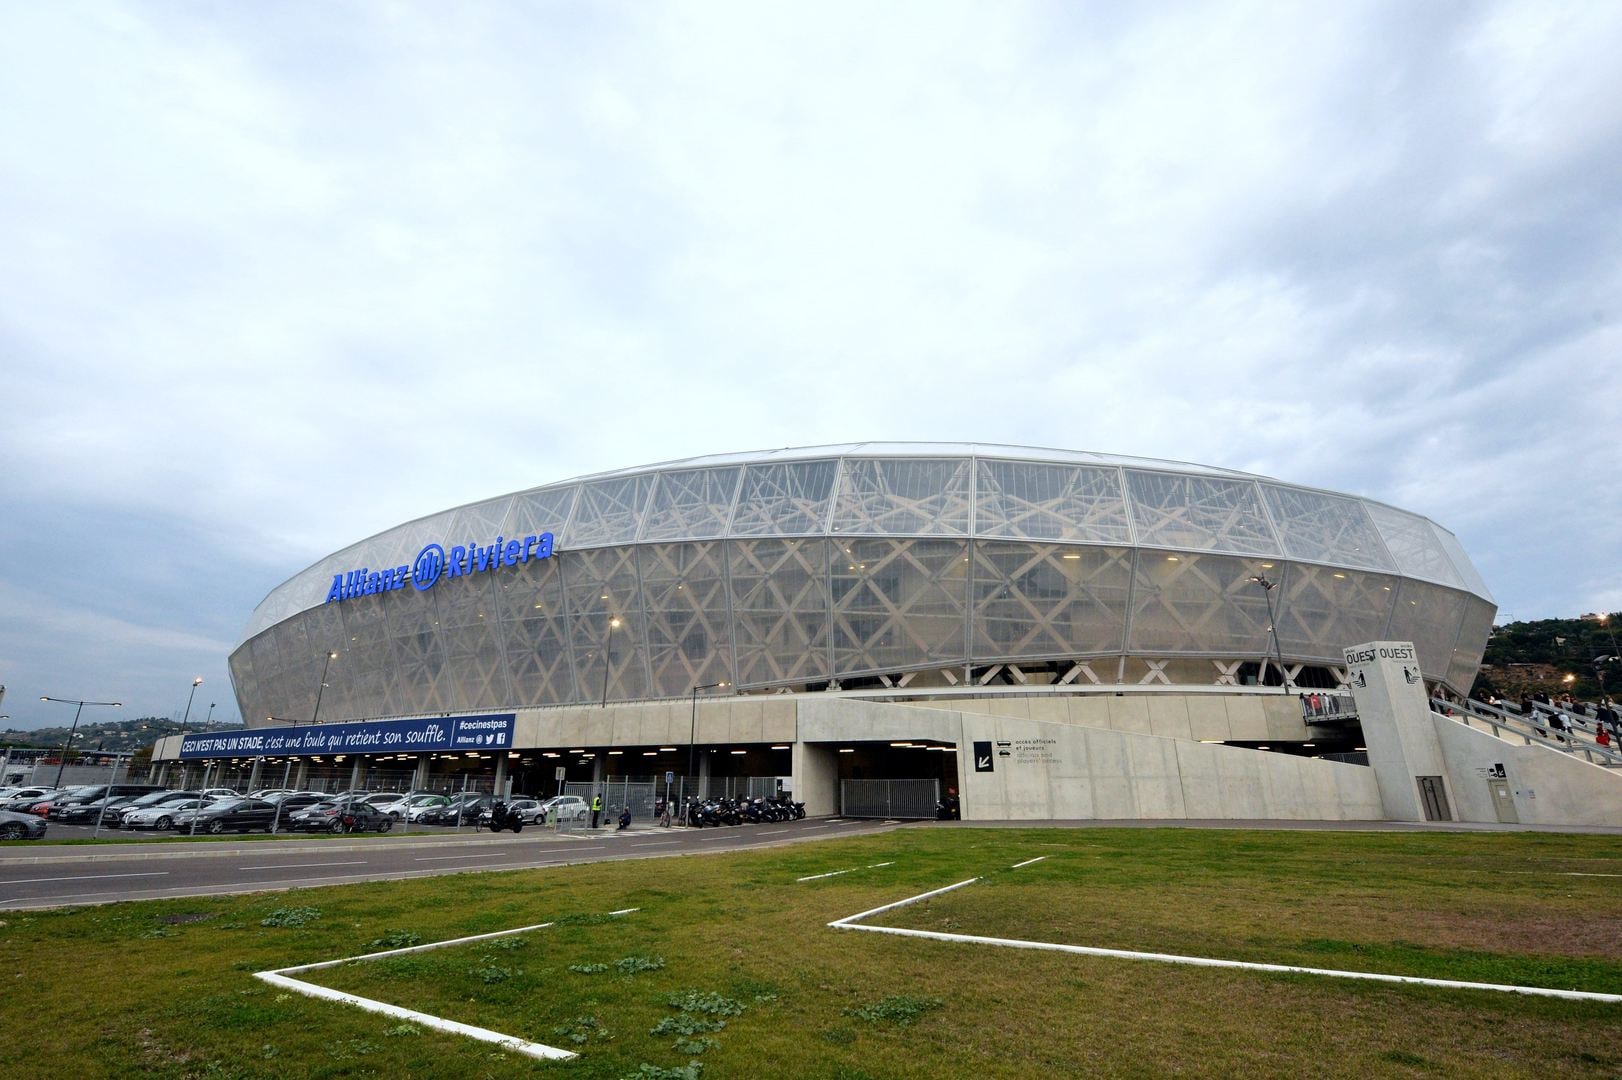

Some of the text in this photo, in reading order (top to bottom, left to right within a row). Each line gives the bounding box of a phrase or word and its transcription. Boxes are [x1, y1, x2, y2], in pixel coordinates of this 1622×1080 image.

[325, 532, 554, 604] Allianz Riviera
[1346, 649, 1376, 664] OUEST
[1380, 648, 1413, 659] OUEST
[459, 720, 507, 731] #cecinestpas
[182, 724, 446, 752] CECI N'EST PAS UN STADE, c'est une foule qui retient son souffle.
[457, 736, 475, 744] Allianz
